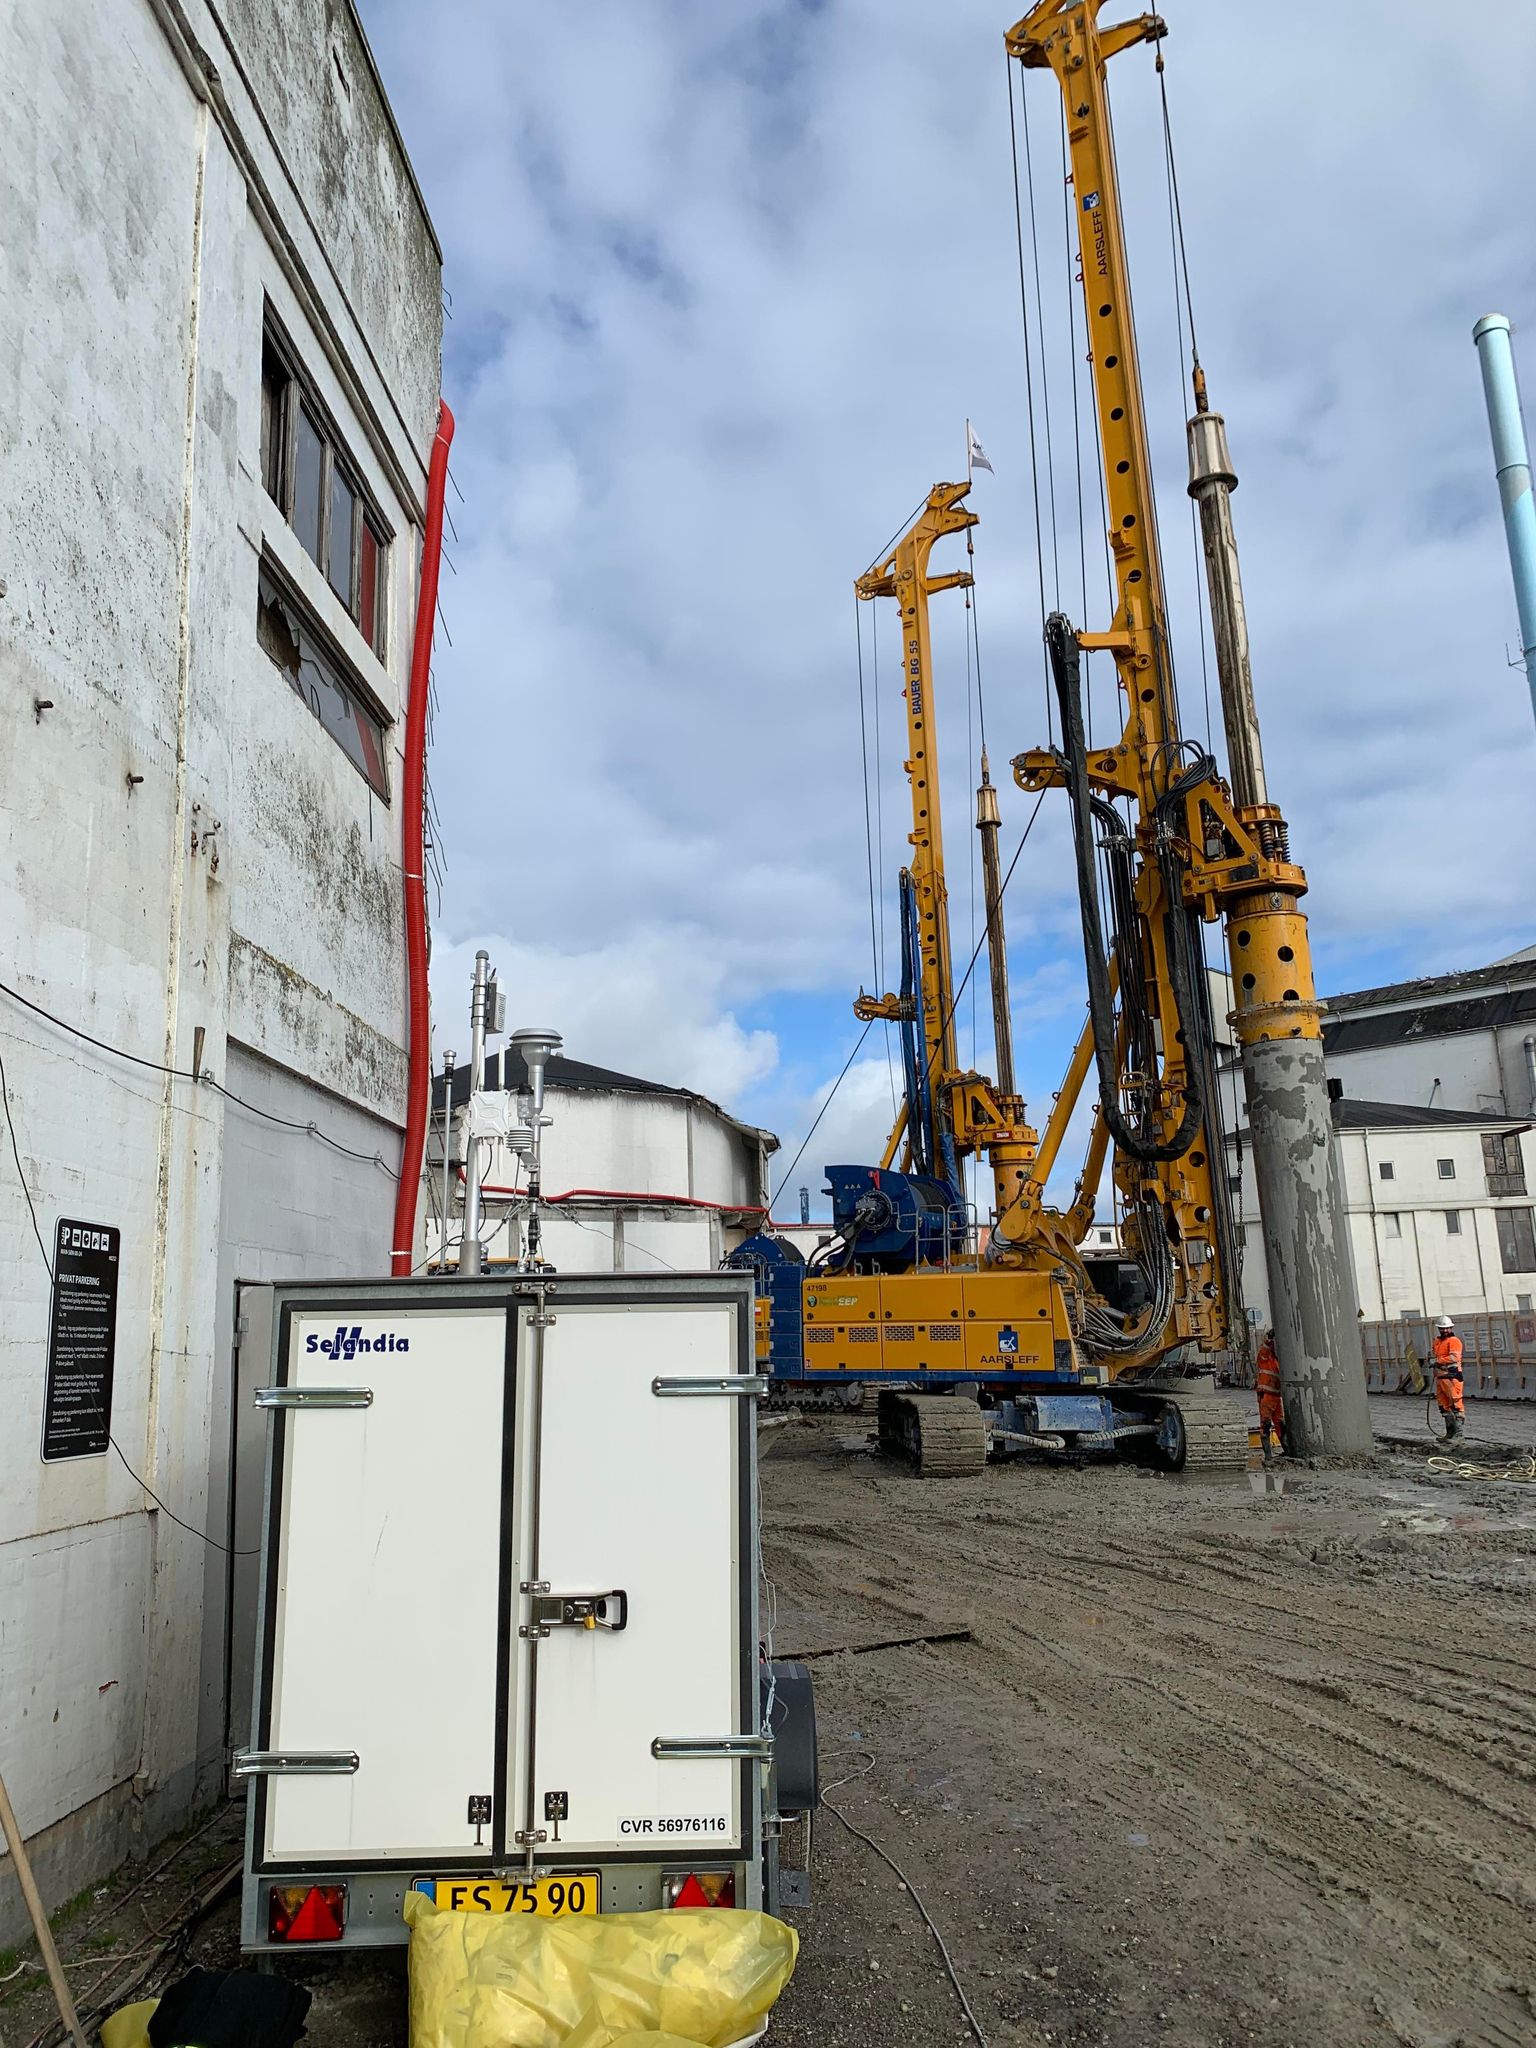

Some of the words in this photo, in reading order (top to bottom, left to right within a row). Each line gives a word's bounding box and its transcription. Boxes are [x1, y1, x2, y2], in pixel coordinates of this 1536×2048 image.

[1092, 210, 1108, 275] AARSLEFF
[909, 640, 918, 654] 55
[910, 658, 920, 675] BG
[911, 680, 922, 715] BAUER
[58, 1273, 75, 1284] PRIVAT
[75, 1275, 100, 1287] PARKERING
[305, 1333, 410, 1353] Selandia
[980, 1355, 1040, 1364] AARSLEFF
[620, 1820, 653, 1833] CVR
[657, 1818, 726, 1832] 56976116
[501, 1884, 538, 1913] 75
[547, 1881, 586, 1915] 90
